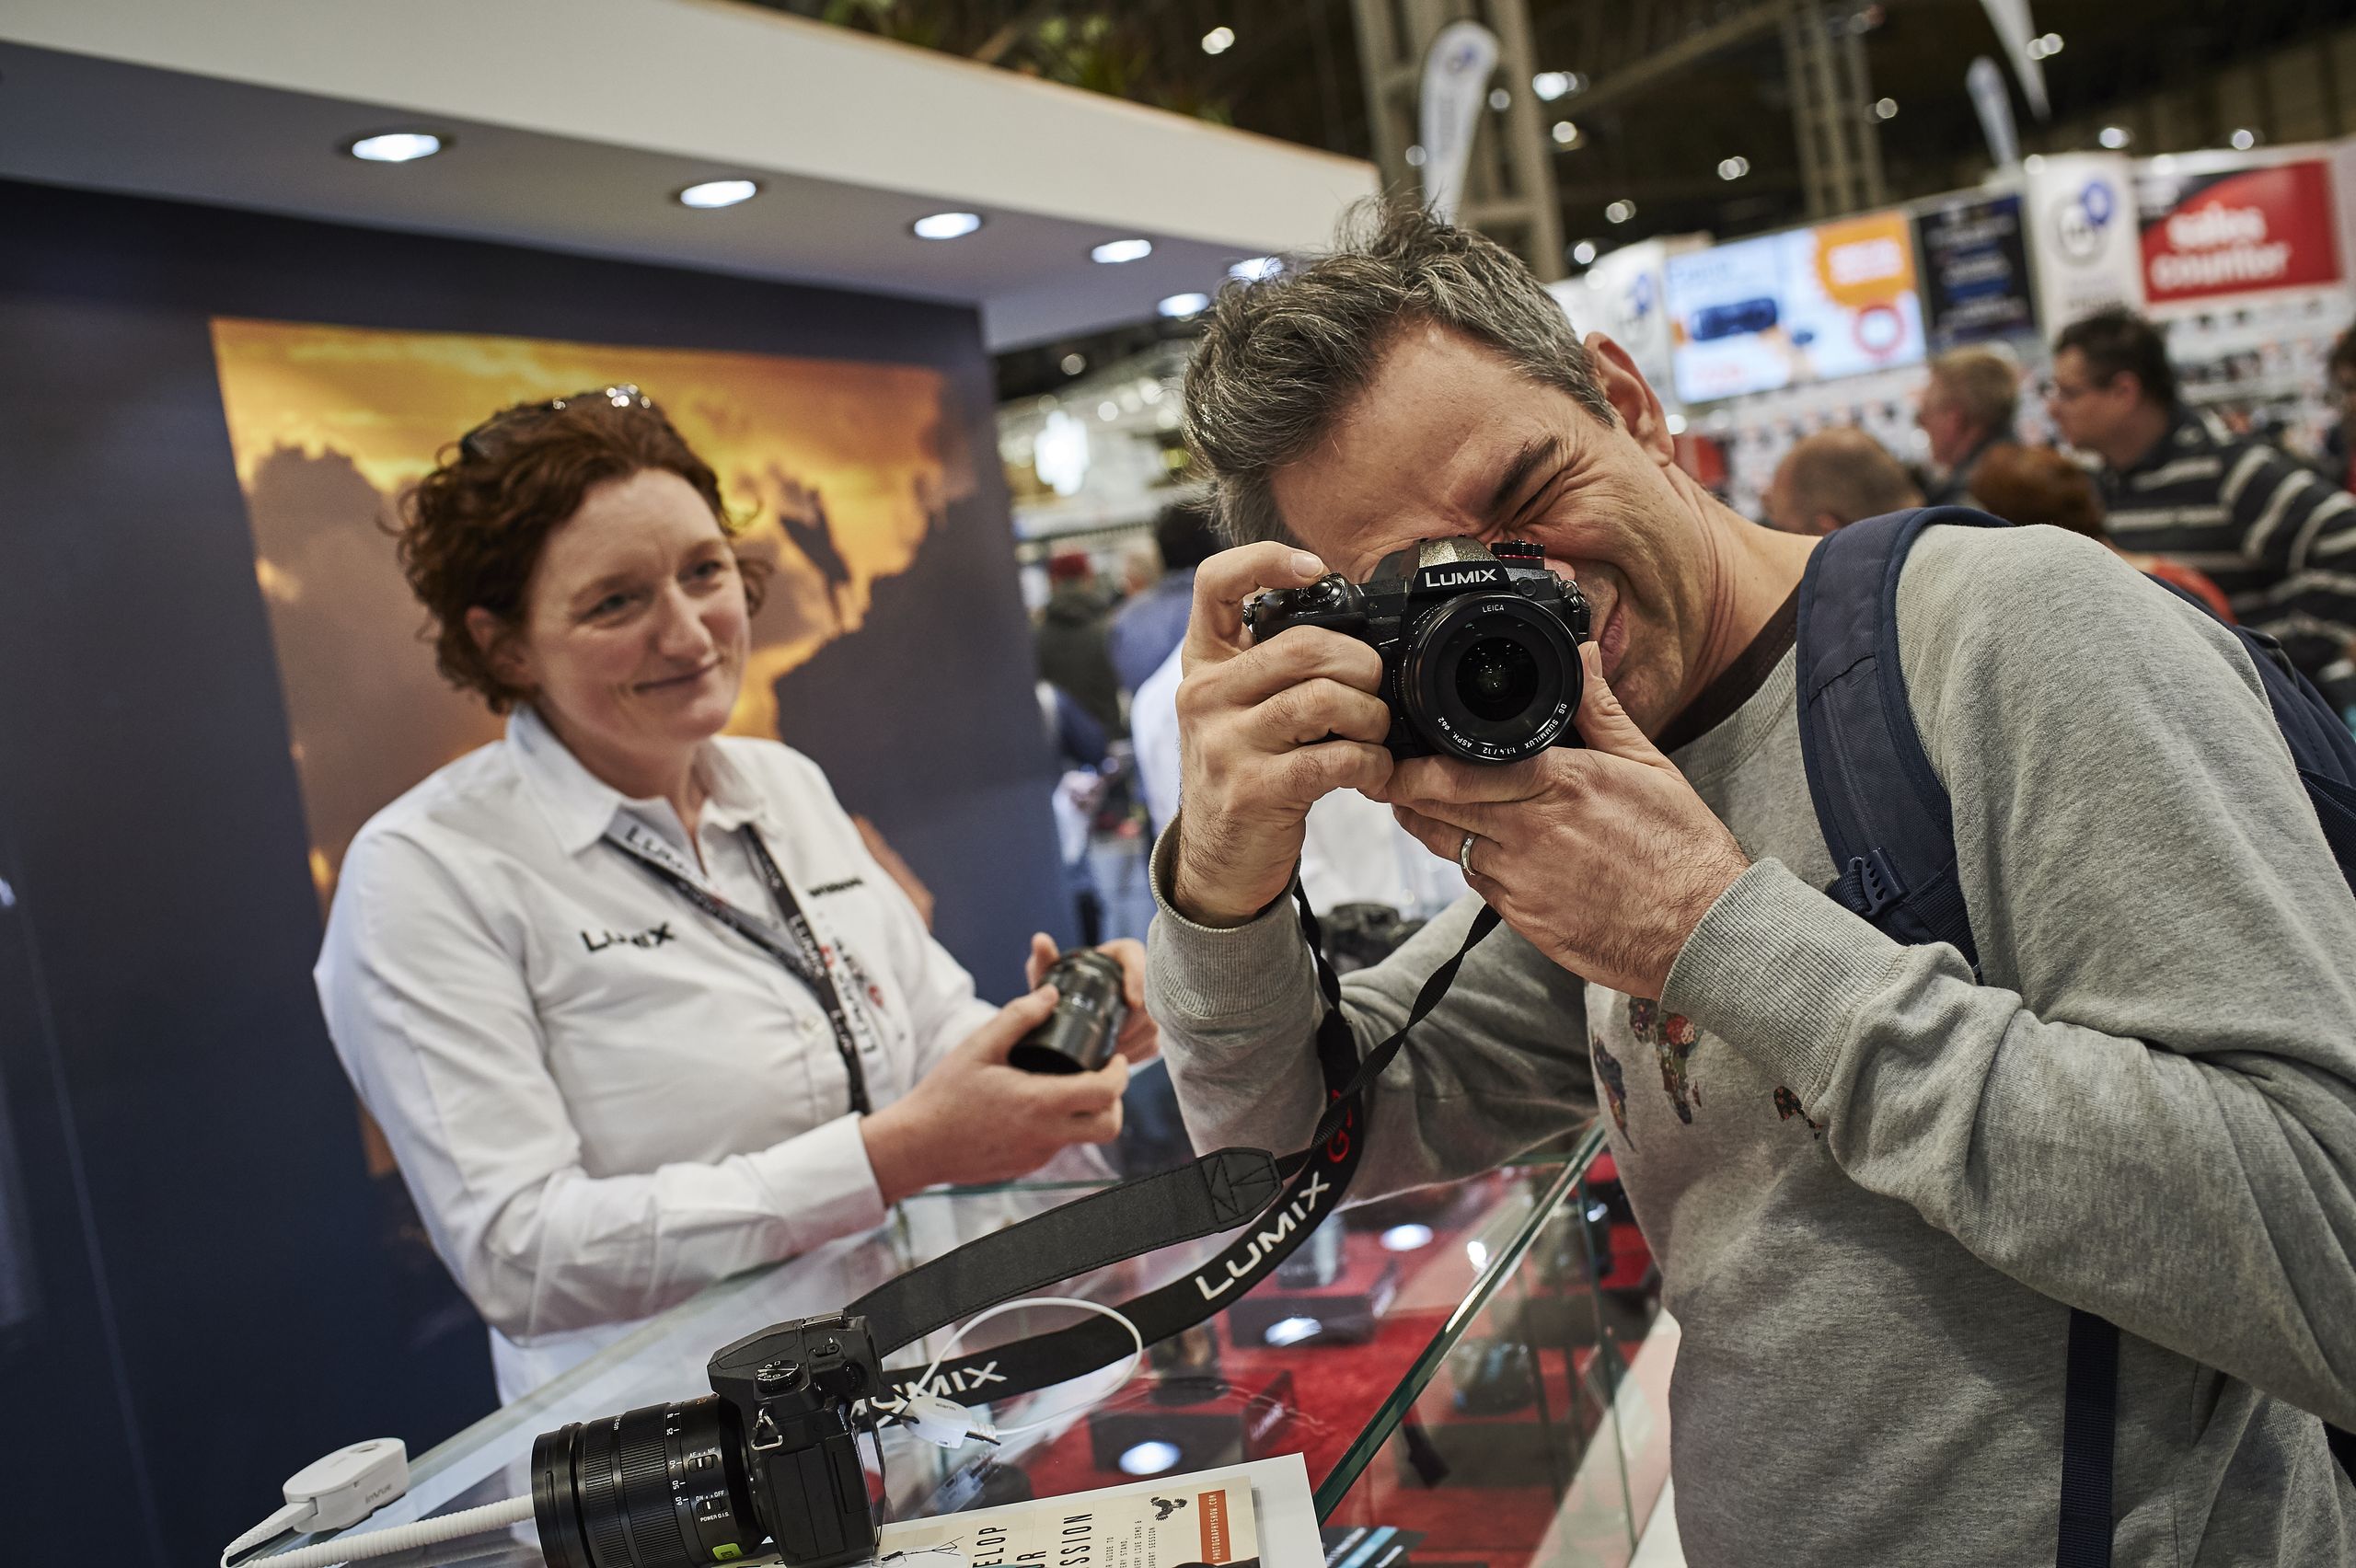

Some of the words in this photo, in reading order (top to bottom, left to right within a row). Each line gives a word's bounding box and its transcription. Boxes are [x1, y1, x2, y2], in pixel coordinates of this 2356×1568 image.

[2166, 202, 2268, 248] sales
[2151, 242, 2290, 290] counter
[1425, 569, 1497, 587] LUMIX
[1483, 605, 1504, 613] LEICA
[1558, 703, 1567, 715] DG
[1524, 719, 1559, 749] SUMMILUX
[1195, 1170, 1331, 1301] LUMIX
[852, 1361, 1008, 1417] UMIX
[672, 1480, 680, 1490] 50
[713, 1490, 725, 1498] OFF
[675, 1496, 683, 1506] 60
[700, 1515, 718, 1523] POWER
[1208, 1494, 1220, 1561] PHOTOGRAPHYSHOW.COM
[1148, 1527, 1156, 1549] SESSION
